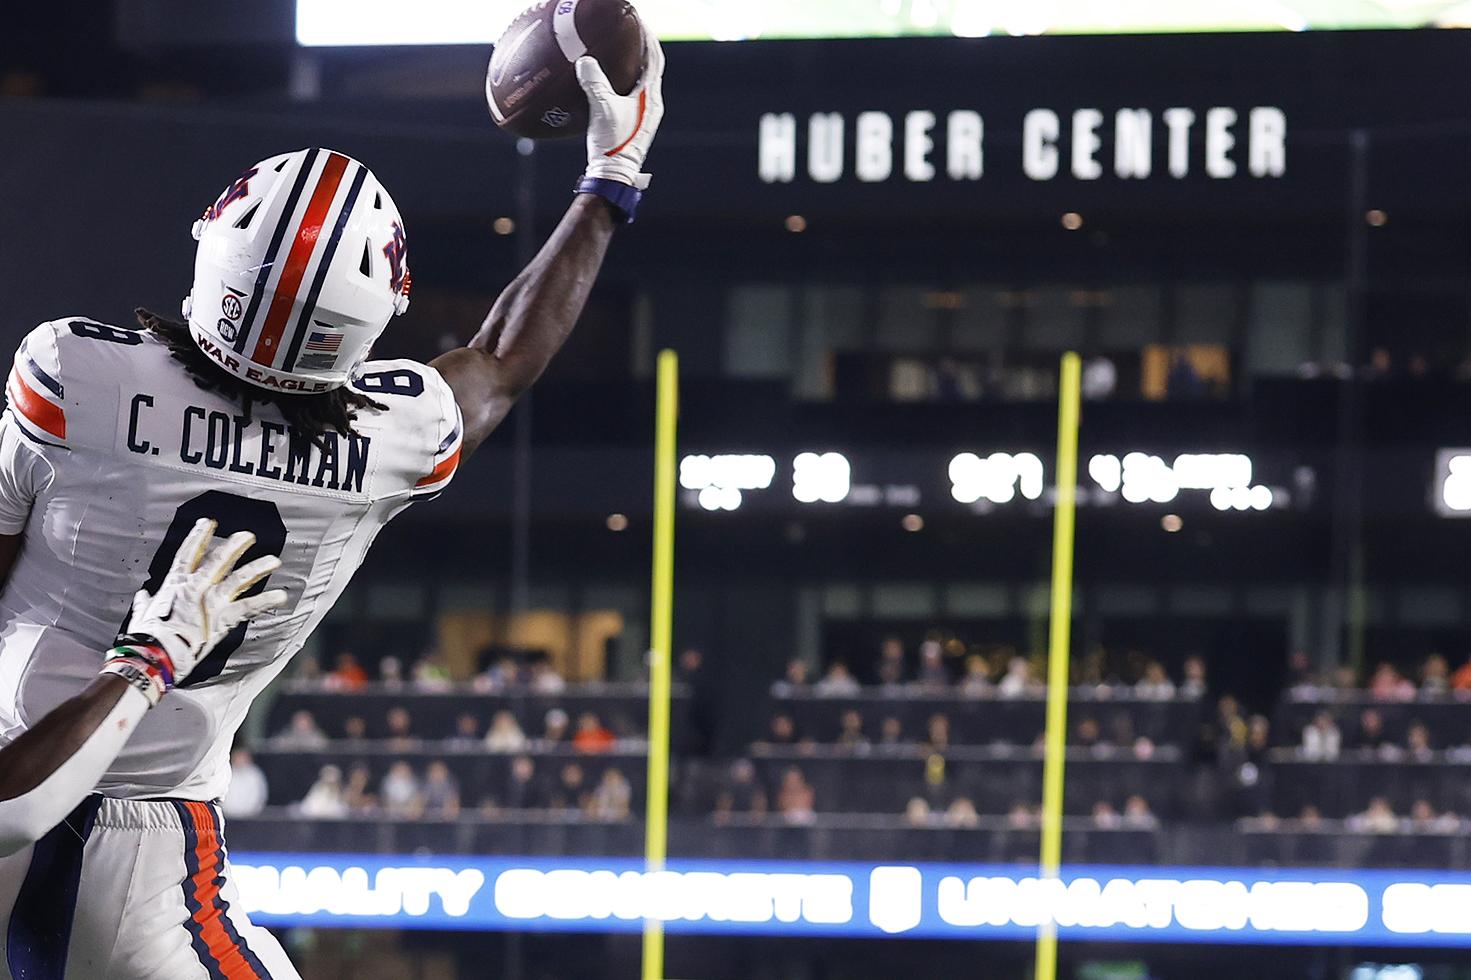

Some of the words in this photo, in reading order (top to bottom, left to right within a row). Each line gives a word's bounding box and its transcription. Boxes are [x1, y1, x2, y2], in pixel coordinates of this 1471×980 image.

[758, 110, 984, 183] HUBER
[1022, 107, 1287, 180] CENTER
[223, 297, 239, 318] SEC
[68, 321, 144, 346] 8
[197, 333, 240, 373] WAR
[246, 366, 328, 393] EAGLE
[351, 368, 425, 398] 8
[127, 393, 160, 456] C.
[180, 404, 371, 493] COLEMAN
